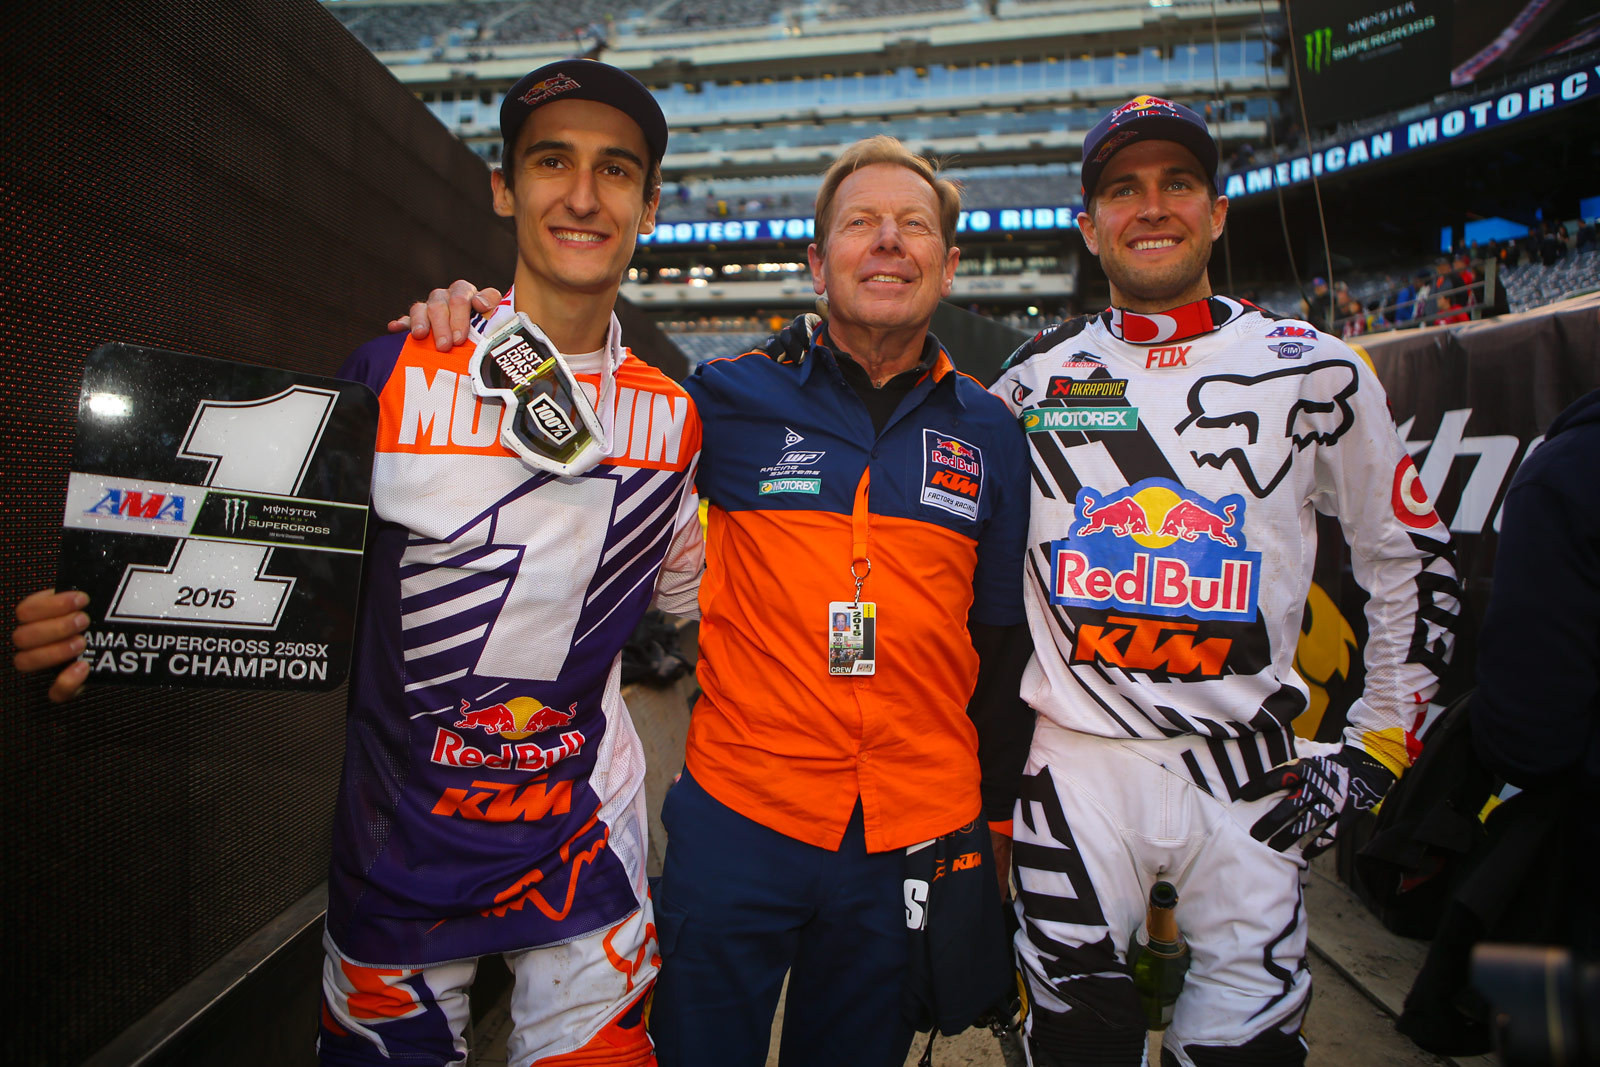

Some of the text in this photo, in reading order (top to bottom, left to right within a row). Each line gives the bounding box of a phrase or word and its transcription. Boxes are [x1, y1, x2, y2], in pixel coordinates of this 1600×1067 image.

[1332, 15, 1436, 61] SUPERCROSS
[1225, 131, 1393, 198] AMERICAN
[1265, 326, 1318, 340] AMA
[506, 348, 539, 378] COAST
[516, 342, 544, 367] EAST
[1145, 345, 1192, 369] FOX
[1070, 381, 1126, 396] AKRAPOVIČ
[534, 403, 571, 438] 100%
[1043, 411, 1128, 426] MOTOREX
[783, 453, 818, 463] WP
[931, 450, 979, 477] Red Bull
[930, 469, 979, 497] KTM
[83, 488, 187, 522] AMA
[262, 505, 318, 518] MONSTER
[927, 491, 955, 505] FACTORY
[248, 519, 331, 535] SUPERCROSS
[1056, 549, 1252, 613] Red Bull
[174, 587, 237, 609] 2015
[83, 631, 329, 658] AMA SUPERCROSS 250SX
[1074, 615, 1233, 676] KTM
[168, 653, 329, 681] CHAMPION
[430, 726, 586, 772] Red Bull
[430, 773, 575, 823] KTM
[951, 851, 982, 872] KTM
